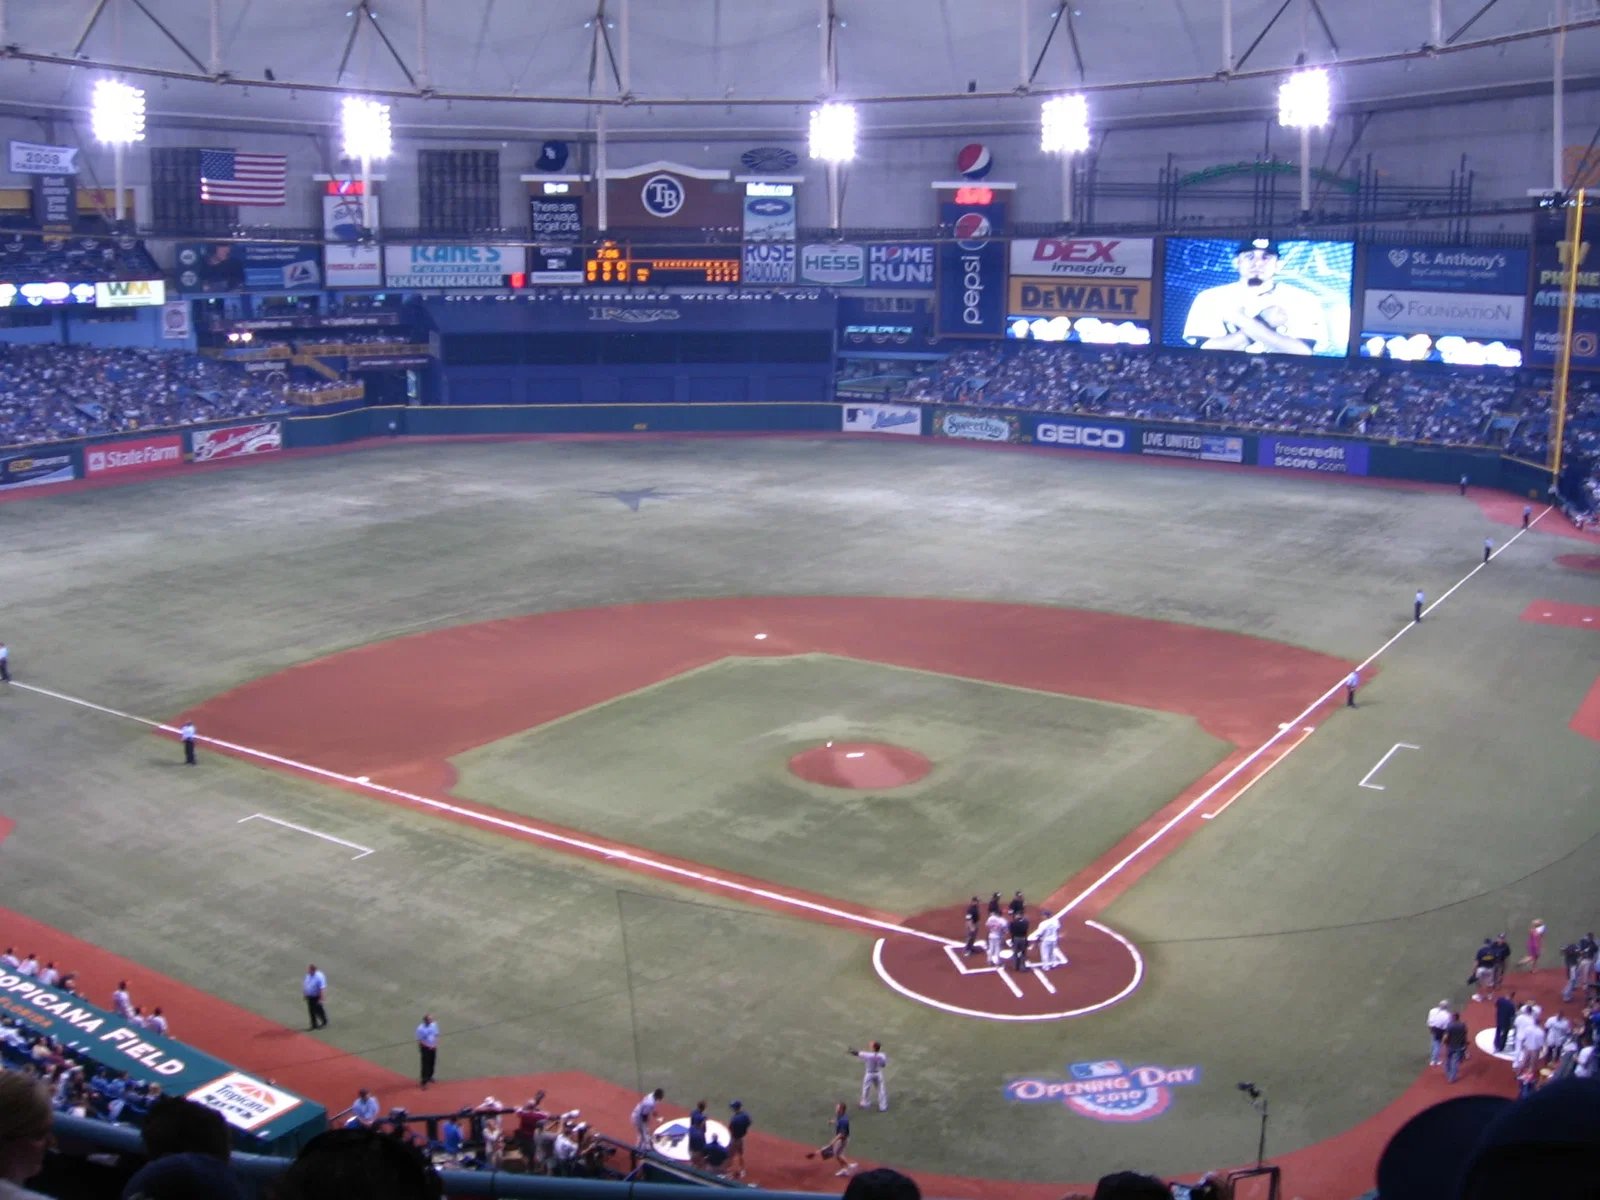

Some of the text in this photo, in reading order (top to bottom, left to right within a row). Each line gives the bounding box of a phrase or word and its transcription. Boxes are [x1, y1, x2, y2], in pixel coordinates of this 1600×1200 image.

[531, 201, 576, 213] There are
[649, 183, 679, 209] TB
[745, 244, 795, 262] ROSE
[1032, 238, 1122, 263] DEX
[1411, 251, 1507, 270] St. Anthony's
[804, 254, 860, 271] HESS
[869, 264, 933, 283] RUN!
[1051, 261, 1127, 276] imaging
[961, 255, 984, 325] pepsi
[948, 414, 1006, 438] Sweetbay
[1036, 424, 1125, 449] GEICO
[1142, 432, 1201, 450] LIVE UNITED
[106, 445, 180, 468] State Farm
[100, 1027, 185, 1075] FIELD
[216, 1084, 270, 1113] Tropicana
